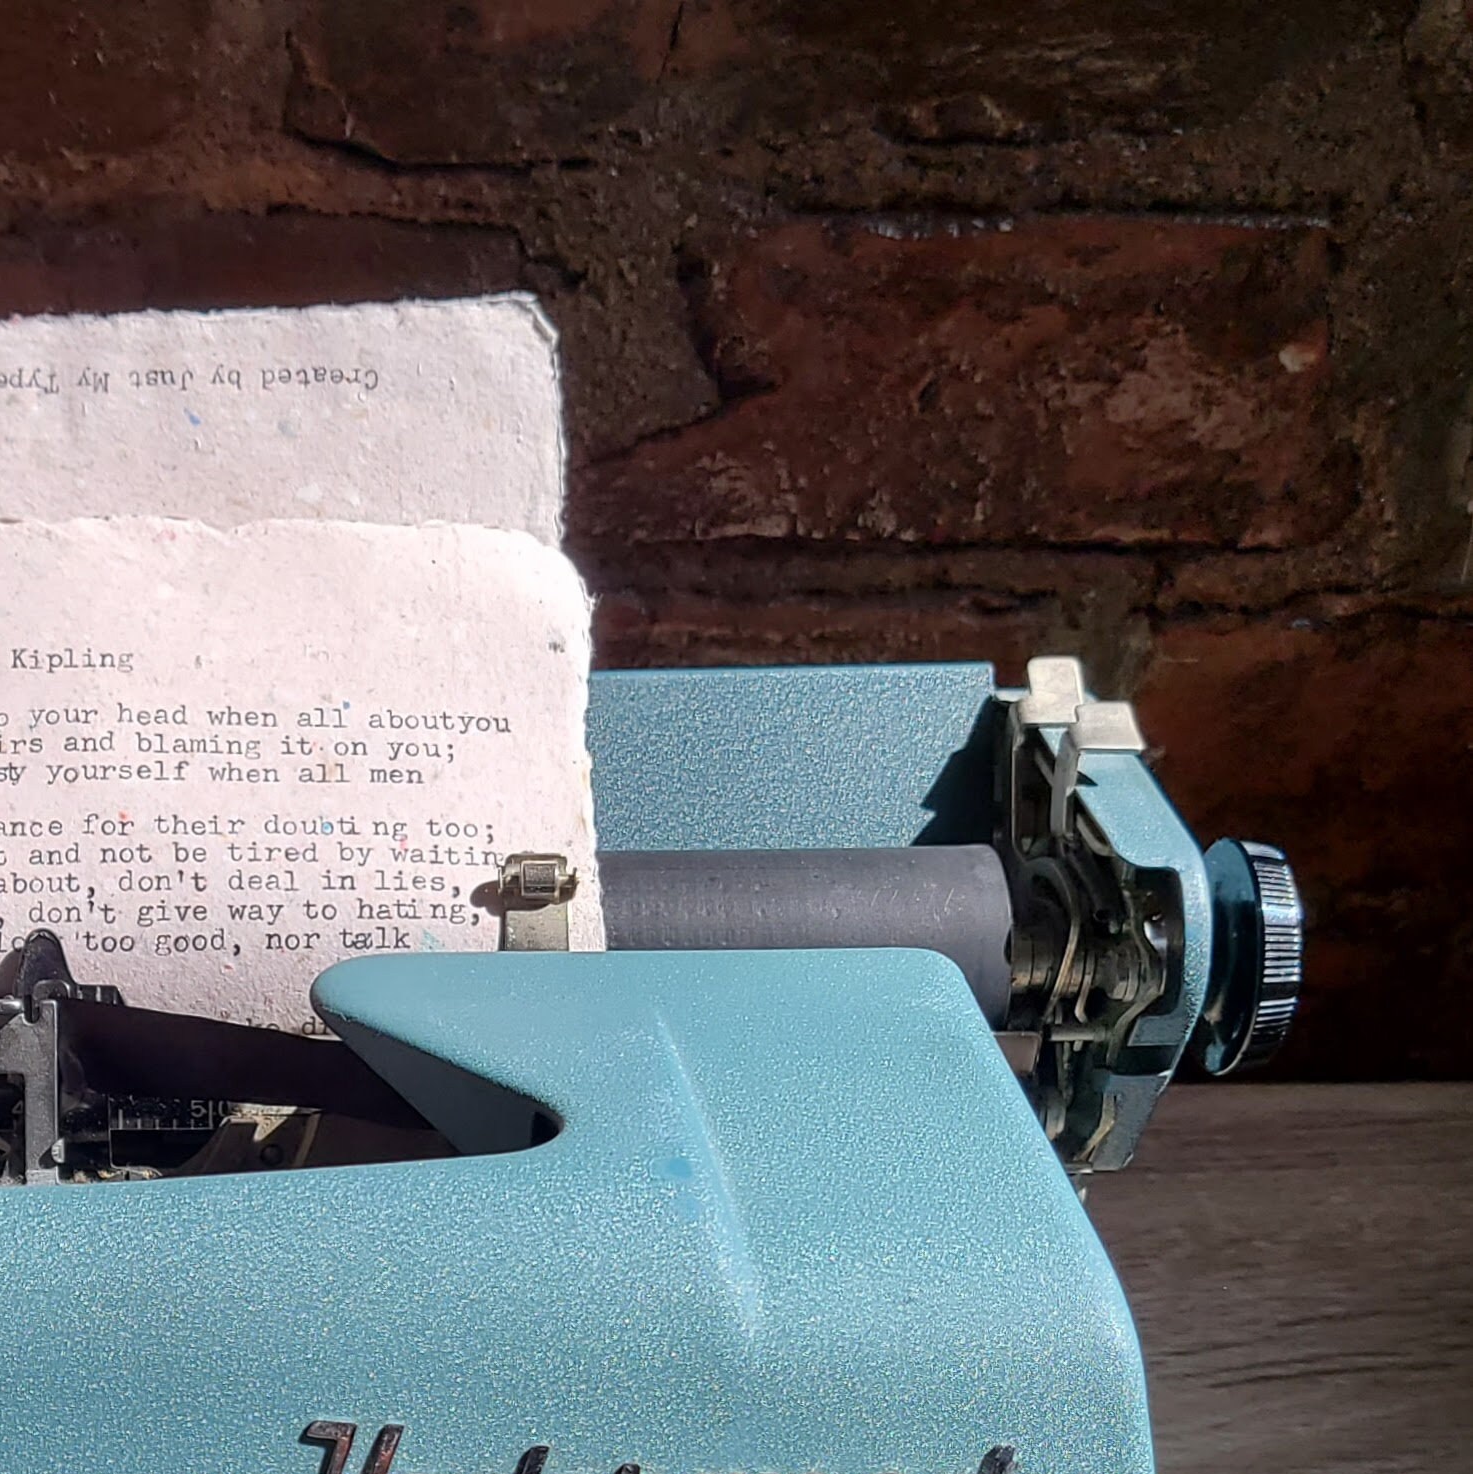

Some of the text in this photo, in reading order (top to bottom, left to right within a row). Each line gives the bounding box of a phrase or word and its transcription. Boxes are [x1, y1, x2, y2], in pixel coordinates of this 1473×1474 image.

[76, 366, 110, 393] My
[129, 369, 194, 391] Just
[211, 364, 242, 390] by
[261, 366, 379, 391] Created
[11, 647, 134, 674] Kipling
[28, 708, 99, 731] your
[117, 702, 188, 726] head
[206, 705, 278, 728] when
[297, 707, 347, 729] all
[63, 730, 115, 753] and
[135, 731, 261, 760] blaming
[281, 735, 313, 756] it
[333, 741, 368, 756] on
[386, 742, 454, 764] you;
[45, 760, 190, 786] yourself
[208, 761, 280, 784] when
[298, 762, 350, 784] all
[369, 768, 424, 785] men
[82, 813, 135, 837] for
[153, 813, 246, 836] their
[426, 819, 494, 845] too;
[28, 841, 81, 866] and
[99, 843, 153, 864] not
[172, 841, 207, 863] be
[227, 841, 319, 863] tired
[336, 841, 373, 867] by
[390, 844, 504, 866] waitin
[118, 869, 207, 893] don't
[228, 868, 300, 892] deal
[321, 869, 357, 891] in
[374, 869, 461, 899] lies,
[28, 899, 117, 925] don't
[136, 904, 208, 928] give
[227, 904, 285, 926] way
[302, 899, 338, 921] to
[82, 930, 136, 954] too
[154, 927, 241, 958] good,
[264, 932, 321, 953] nor
